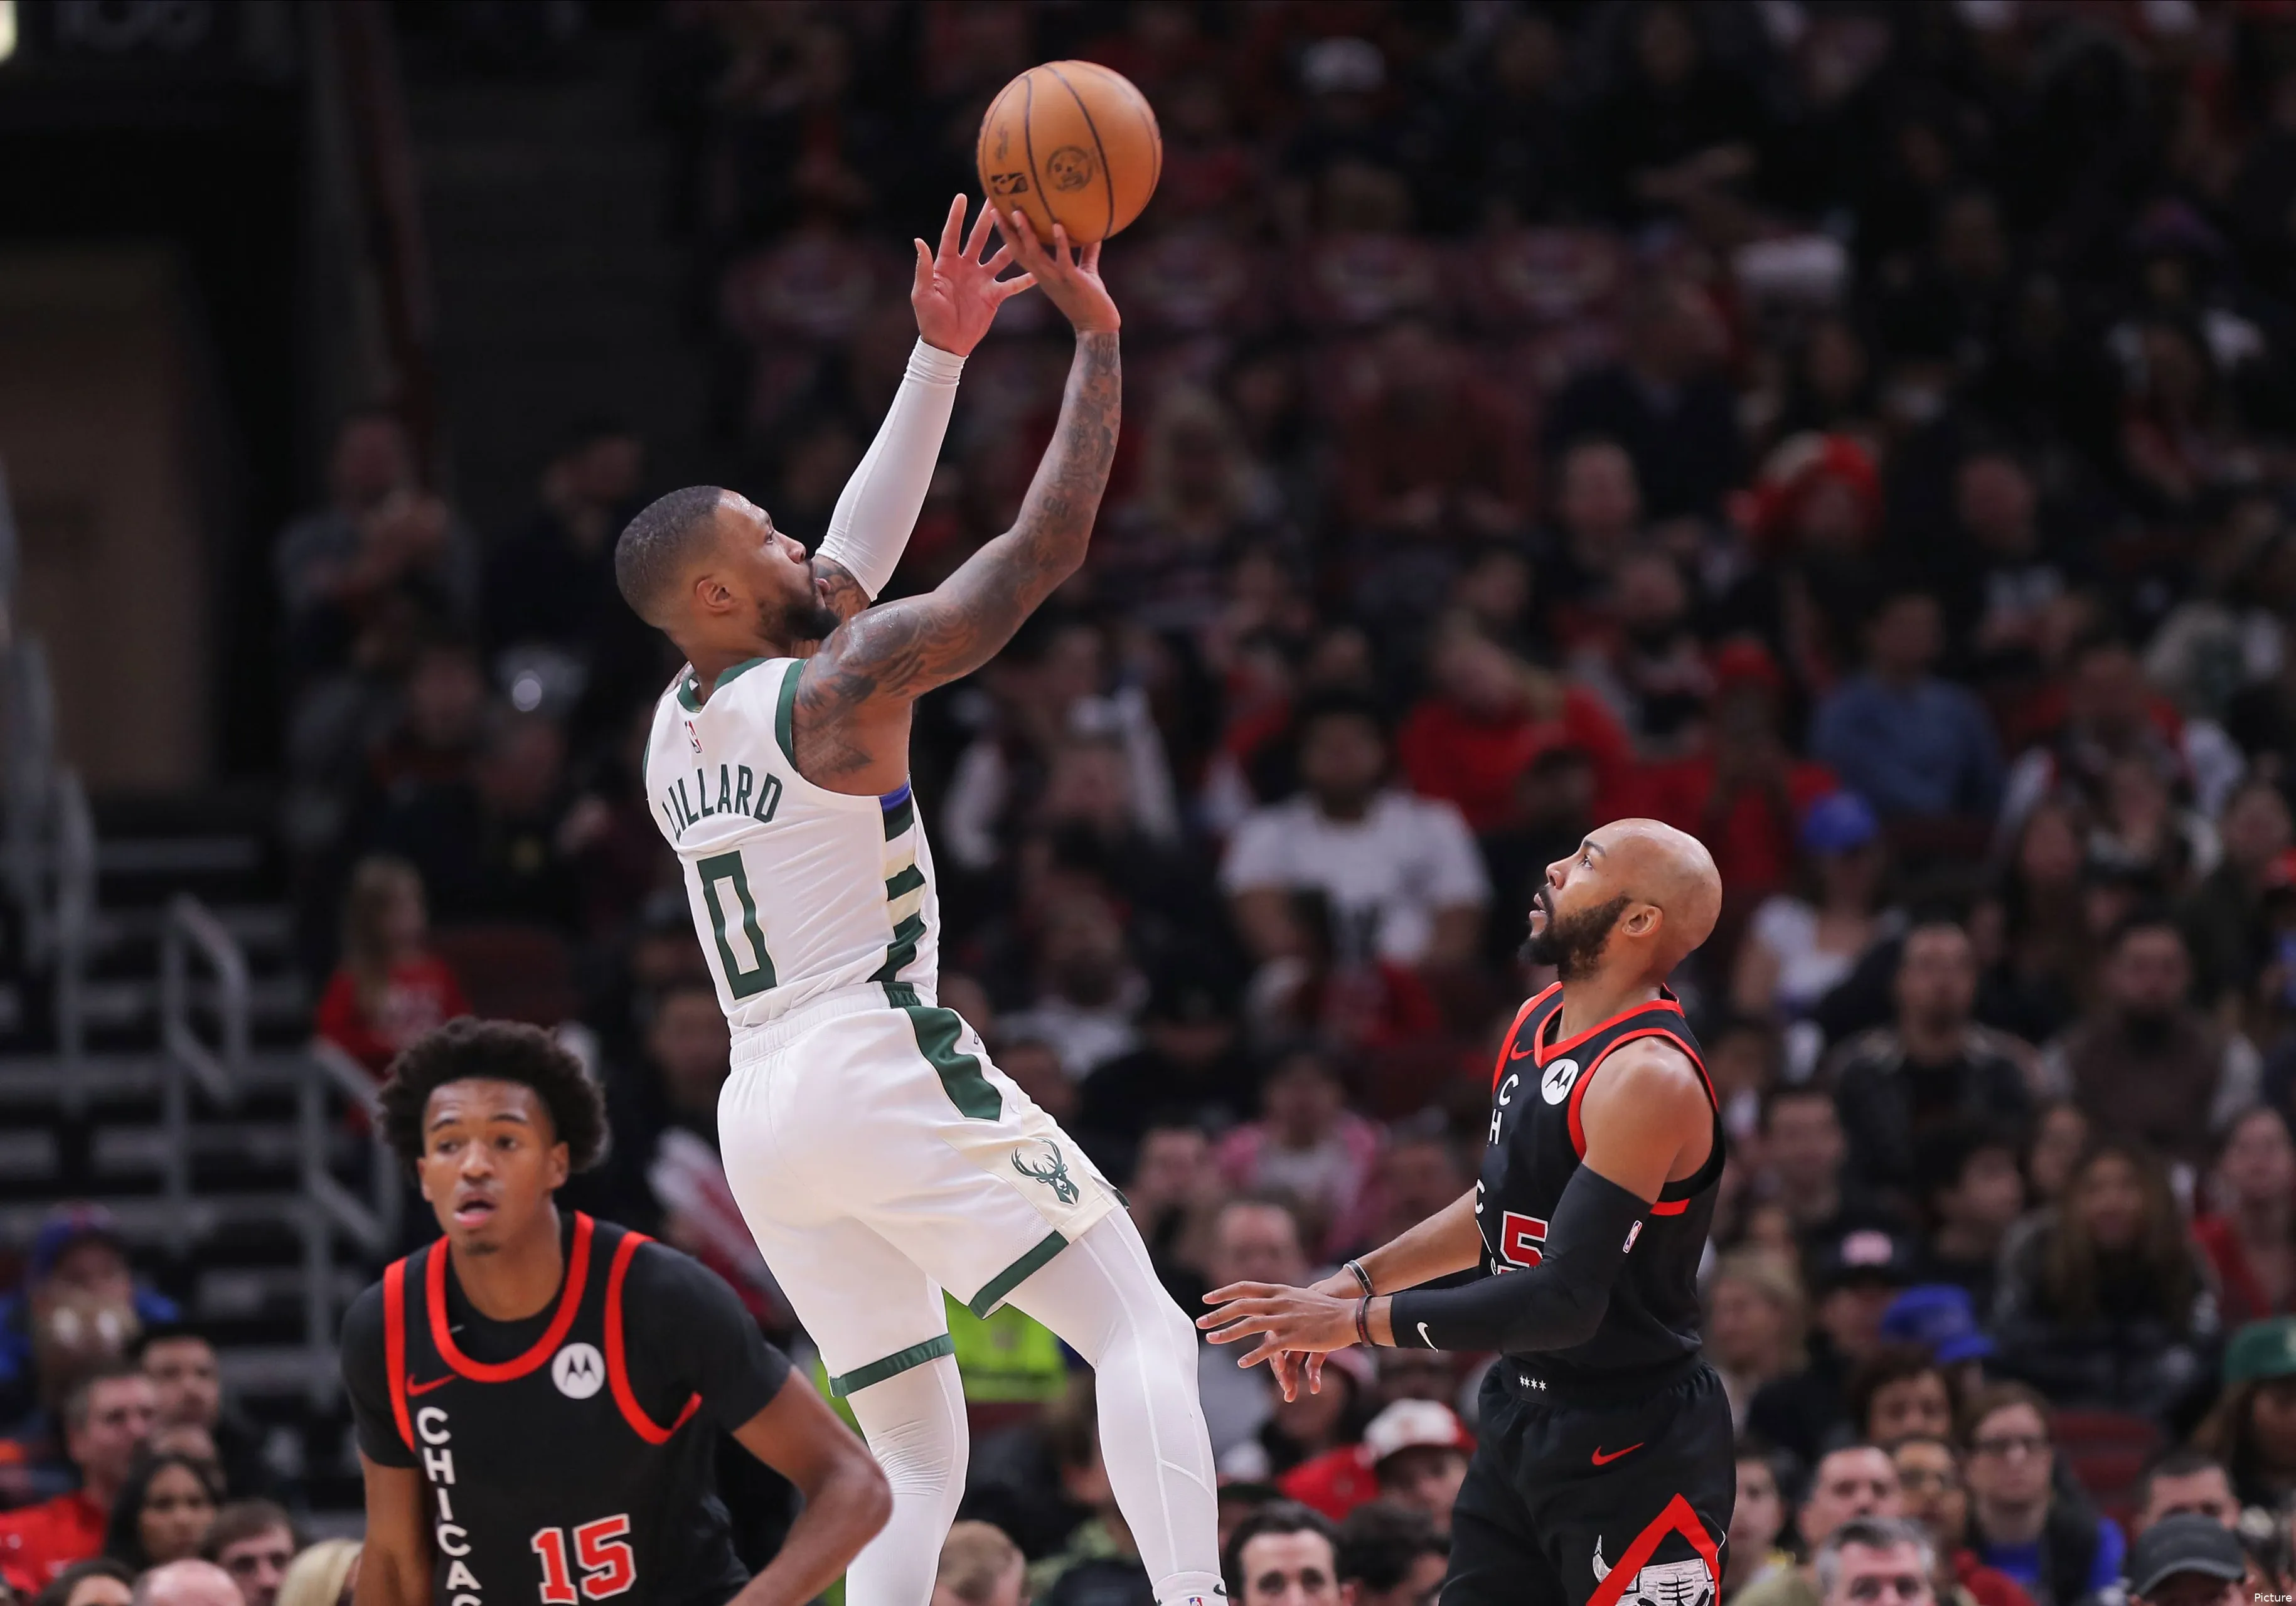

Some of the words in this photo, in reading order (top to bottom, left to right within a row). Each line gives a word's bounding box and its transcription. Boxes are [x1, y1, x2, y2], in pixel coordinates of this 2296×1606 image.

[661, 763, 783, 844] LILLARD
[695, 848, 779, 1002] 0
[530, 1512, 638, 1605] 15
